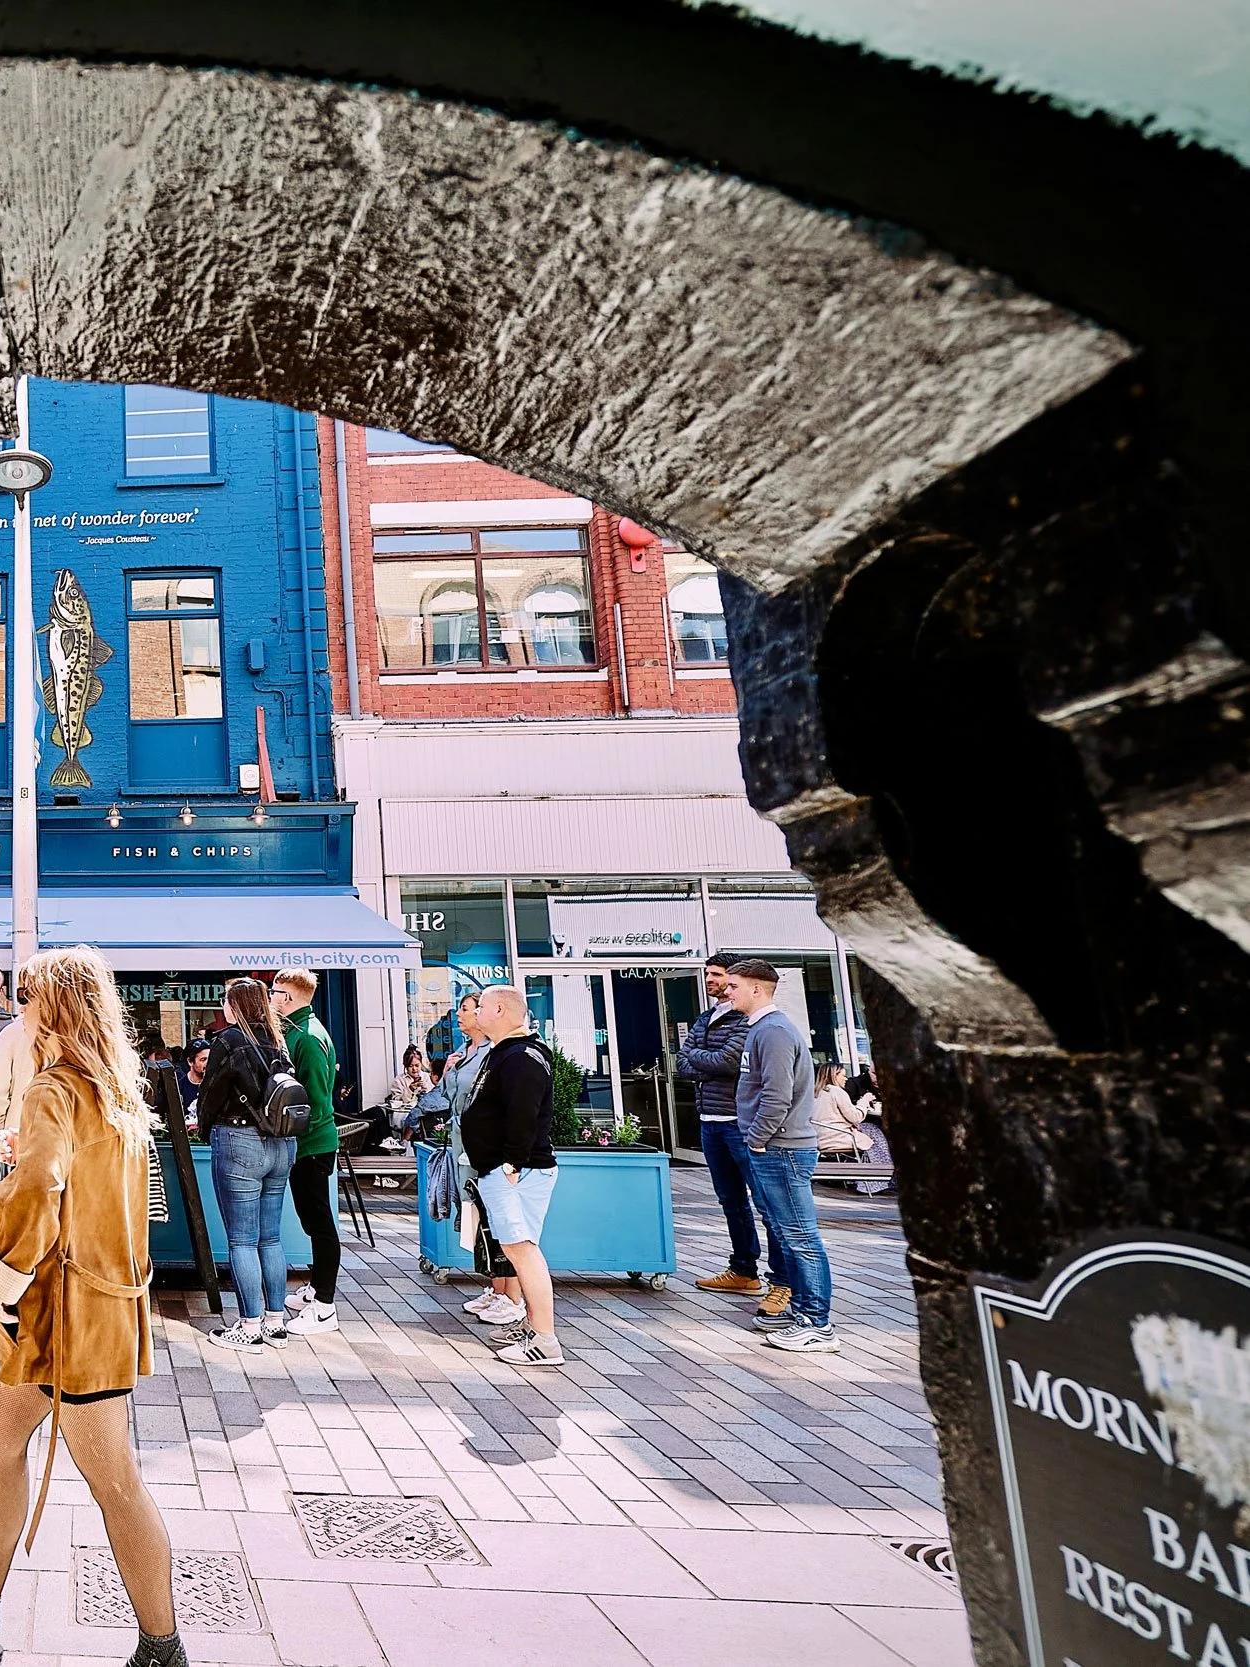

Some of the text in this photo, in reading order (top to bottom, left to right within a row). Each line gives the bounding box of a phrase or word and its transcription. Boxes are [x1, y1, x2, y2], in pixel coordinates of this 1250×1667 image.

[33, 515, 57, 528] net
[61, 512, 78, 530] of
[80, 511, 137, 526] wonder
[85, 535, 150, 546] Jacques Cousteau
[113, 846, 252, 857] FISH & CHIPS
[229, 951, 400, 967] www.fish-city.com
[122, 984, 156, 1001] ISH
[177, 984, 225, 1001] CHIP
